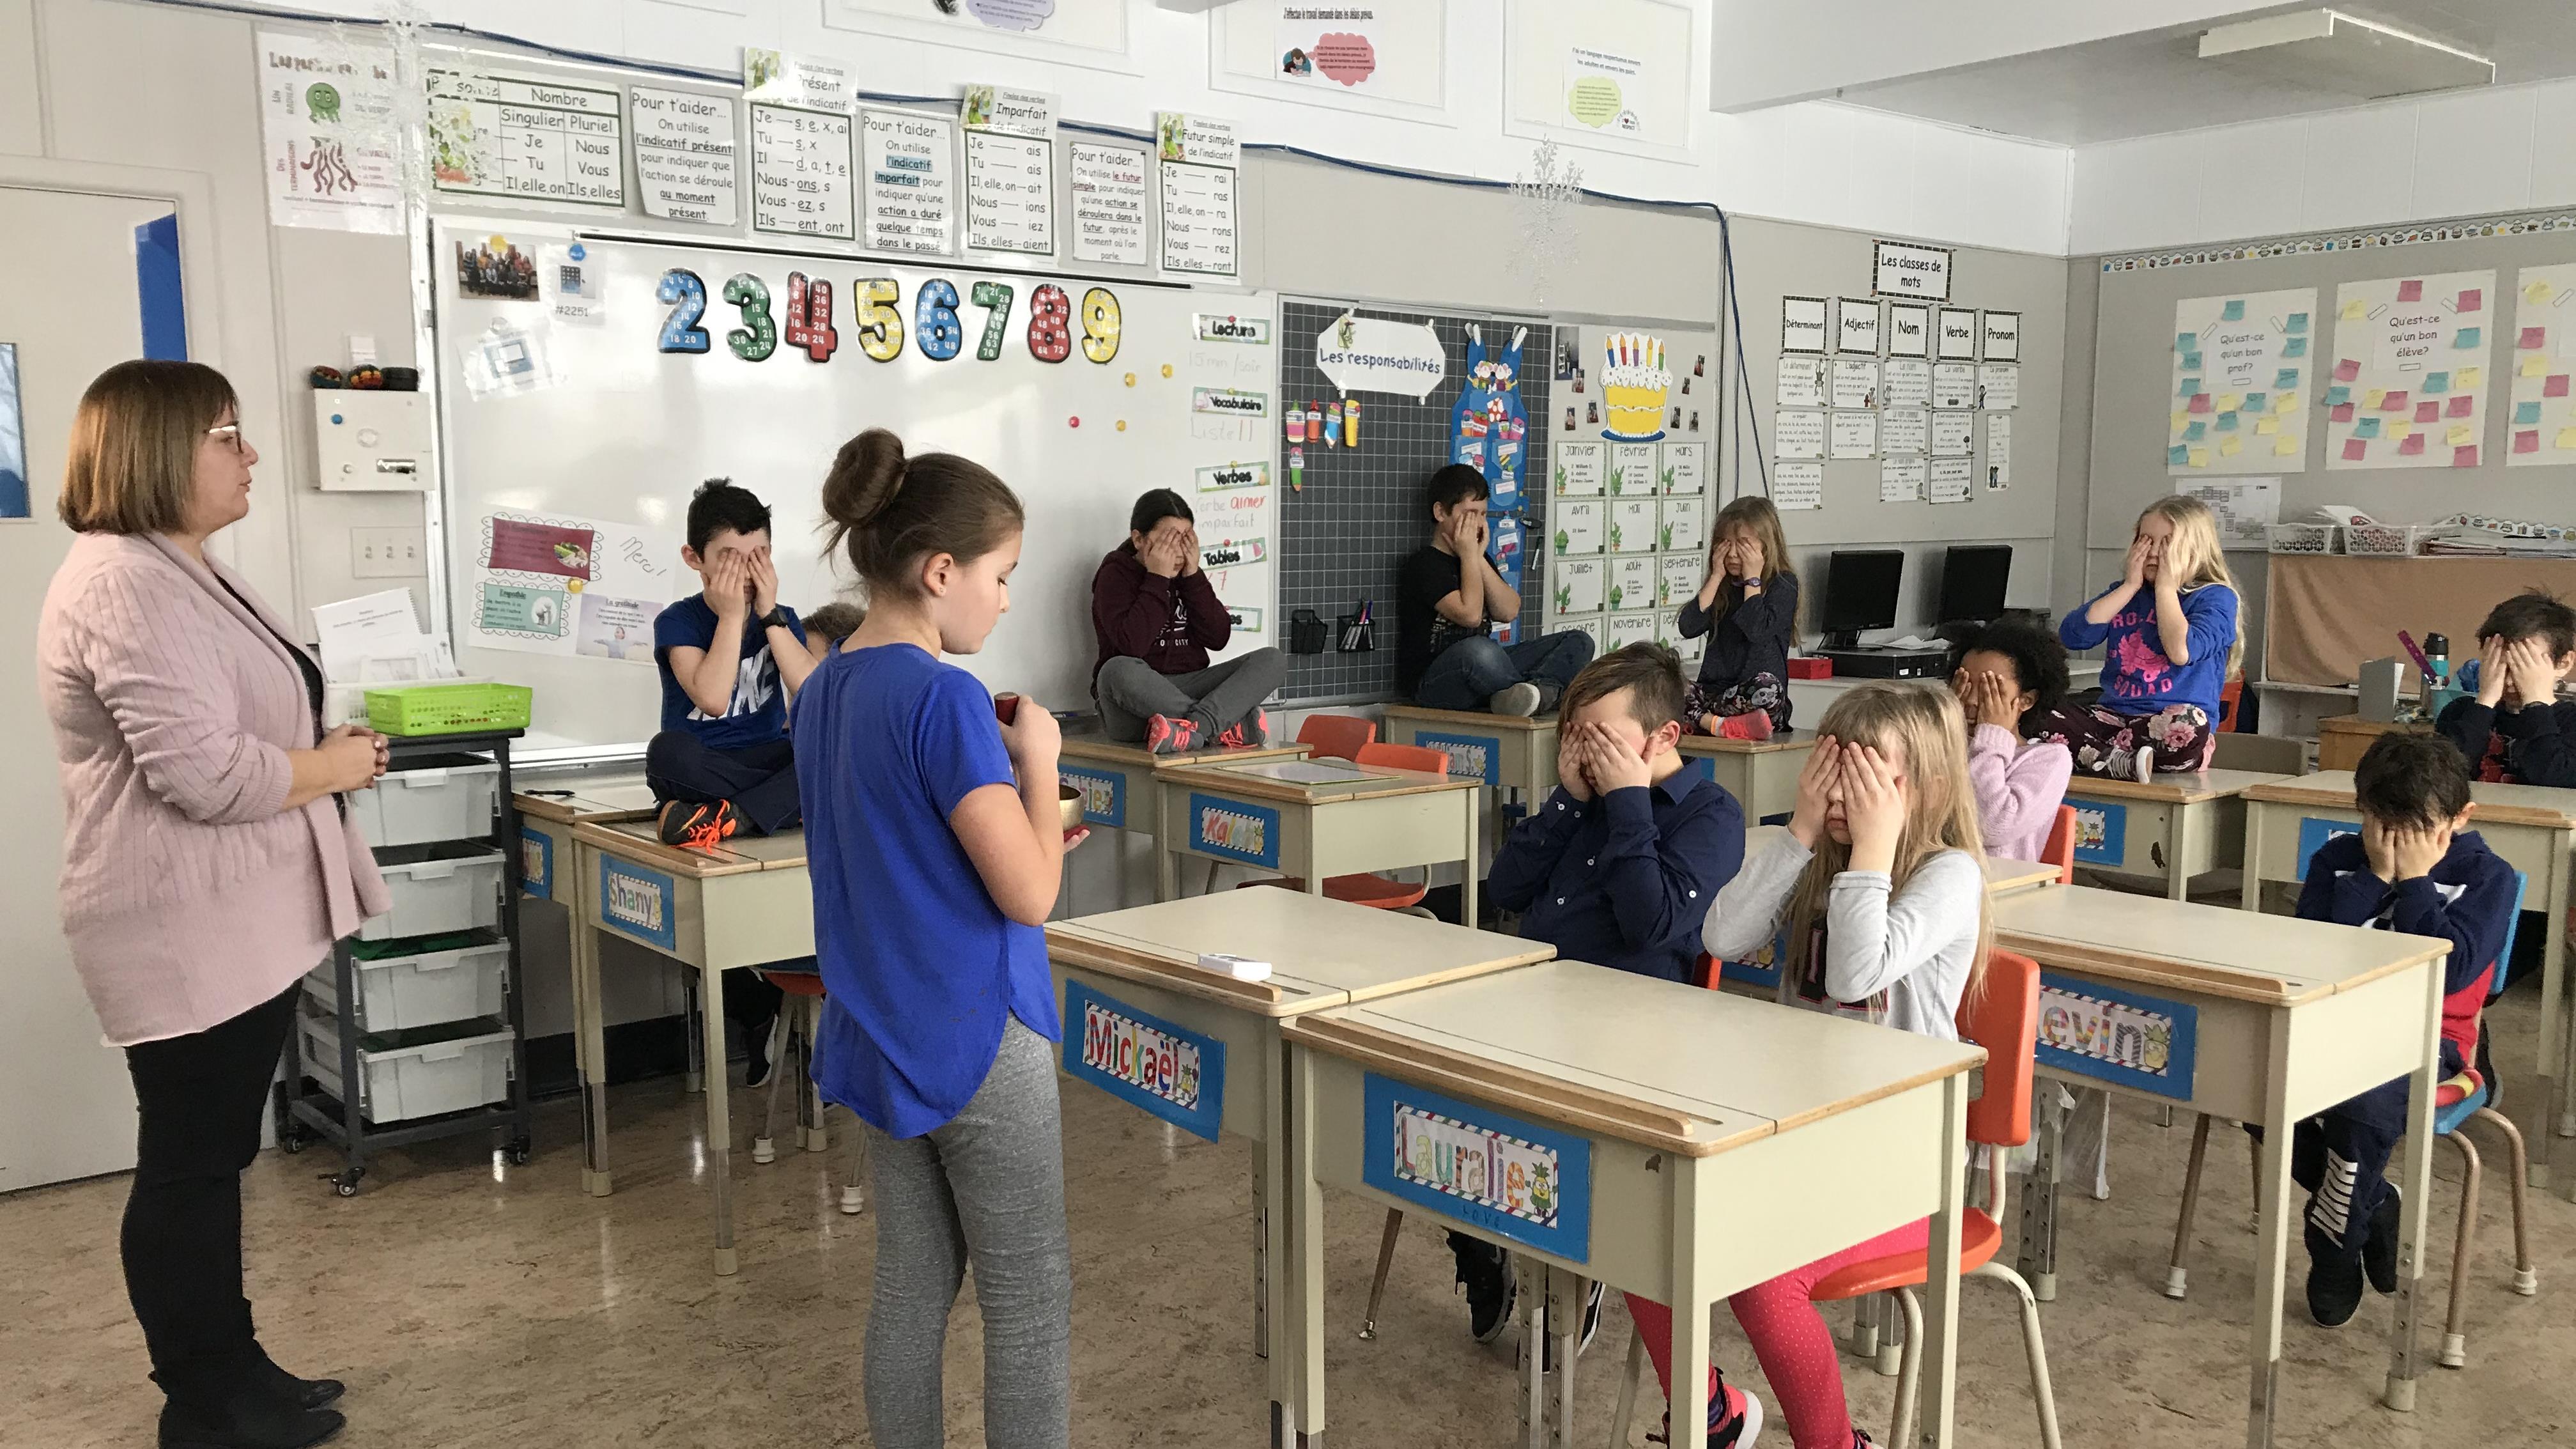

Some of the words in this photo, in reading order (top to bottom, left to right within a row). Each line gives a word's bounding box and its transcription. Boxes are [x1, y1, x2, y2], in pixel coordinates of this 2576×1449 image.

[531, 88, 587, 107] Nombre
[632, 93, 664, 109] Pour
[996, 103, 1047, 120] Imparfait
[501, 109, 564, 127] Singulier
[570, 115, 612, 132] Pluriel
[659, 119, 674, 130] On
[677, 122, 709, 134] utilise
[863, 116, 891, 130] Pour
[525, 134, 543, 148] Je
[576, 139, 609, 155] Nous
[636, 133, 687, 150] l'indicatif
[691, 141, 732, 153] présent
[1182, 129, 1206, 142] Futur
[1208, 134, 1235, 146] simple
[886, 140, 899, 150] On
[902, 143, 931, 154] utilise
[1188, 146, 1198, 156] de
[1199, 148, 1233, 161] l'indicatif
[527, 157, 543, 170] Tu
[578, 162, 609, 176] Vous
[641, 153, 663, 163] pour
[667, 155, 709, 169] indiquer
[712, 160, 730, 172] que
[886, 155, 932, 169] l'indicatif
[641, 168, 677, 182] l'action
[679, 175, 691, 183] se
[694, 175, 732, 188] déroule
[757, 172, 787, 187] Nous
[875, 171, 920, 185] imparfait
[922, 178, 943, 189] pour
[1088, 168, 1110, 178] utilise
[1123, 172, 1141, 182] futur
[1028, 183, 1042, 194] ait
[1073, 182, 1095, 191] simple
[1116, 187, 1145, 197] indiquer
[675, 191, 716, 203] moment
[759, 192, 786, 206] Vous
[875, 189, 913, 201] indiquer
[916, 193, 943, 204] qu'une
[1081, 196, 1103, 205] qu'une
[1105, 199, 1127, 208] action
[971, 195, 998, 208] Nous
[1026, 201, 1045, 213] ions
[877, 206, 906, 216] action
[921, 208, 942, 219] duré
[1077, 209, 1113, 219] déroulera
[1116, 212, 1132, 222] dans
[759, 213, 775, 226] Ils
[825, 222, 844, 233] ont
[876, 222, 911, 234] quelque
[916, 225, 943, 236] temps
[972, 214, 996, 227] Vous
[1029, 220, 1043, 232] iez
[1109, 226, 1129, 235] après
[1212, 226, 1231, 236] rons
[877, 237, 899, 247] dans
[1023, 240, 1048, 251] aient
[1084, 238, 1112, 246] moment
[1213, 261, 1231, 271] ront
[1881, 253, 1897, 268] Les
[1899, 255, 1929, 271] classes
[1931, 261, 1941, 272] de
[1901, 277, 1921, 288] mots
[815, 295, 827, 304] 36
[999, 295, 1010, 303] 28
[555, 306, 589, 316] #2251
[752, 304, 761, 313] 15
[656, 268, 711, 353] 2
[723, 272, 777, 362] 3
[785, 271, 838, 362] 4
[854, 277, 905, 362] 5
[915, 278, 962, 361] 6
[971, 281, 1014, 360] 7
[1028, 284, 1071, 363] 8
[1082, 287, 1121, 364] 9
[937, 312, 948, 320] 60
[2389, 315, 2441, 327] Qu'est-ce
[1212, 321, 1256, 337] Lecture
[1786, 320, 1823, 330] Déterminant
[1844, 318, 1874, 332] Adjectif
[1898, 320, 1919, 336] Nom
[1946, 325, 1968, 338] Verbe
[684, 335, 696, 343] 20
[812, 335, 824, 344] 24
[1987, 328, 2014, 341] Pronom
[2221, 334, 2265, 344] Qu'est-ce
[2390, 332, 2416, 343] qu'un
[2419, 330, 2437, 341] bon
[2221, 349, 2243, 359] qu'un
[2246, 348, 2262, 357] bon
[2396, 346, 2428, 357] élève?
[1320, 348, 1343, 363] Les
[1348, 352, 1440, 375] responsabilités
[2228, 363, 2253, 374] prof?
[1210, 396, 1261, 410] Vocabulaire
[1213, 469, 1252, 485] Verbes
[1231, 496, 1266, 509] aimer
[1199, 513, 1254, 532] imparfait
[1203, 550, 1240, 566] Tables
[2114, 675, 2173, 697] SQUAD
[610, 874, 652, 922] Shany
[2037, 1005, 2142, 1063] evin
[1090, 1014, 1178, 1096] Mickaël
[1401, 1116, 1525, 1207] Lauralie
